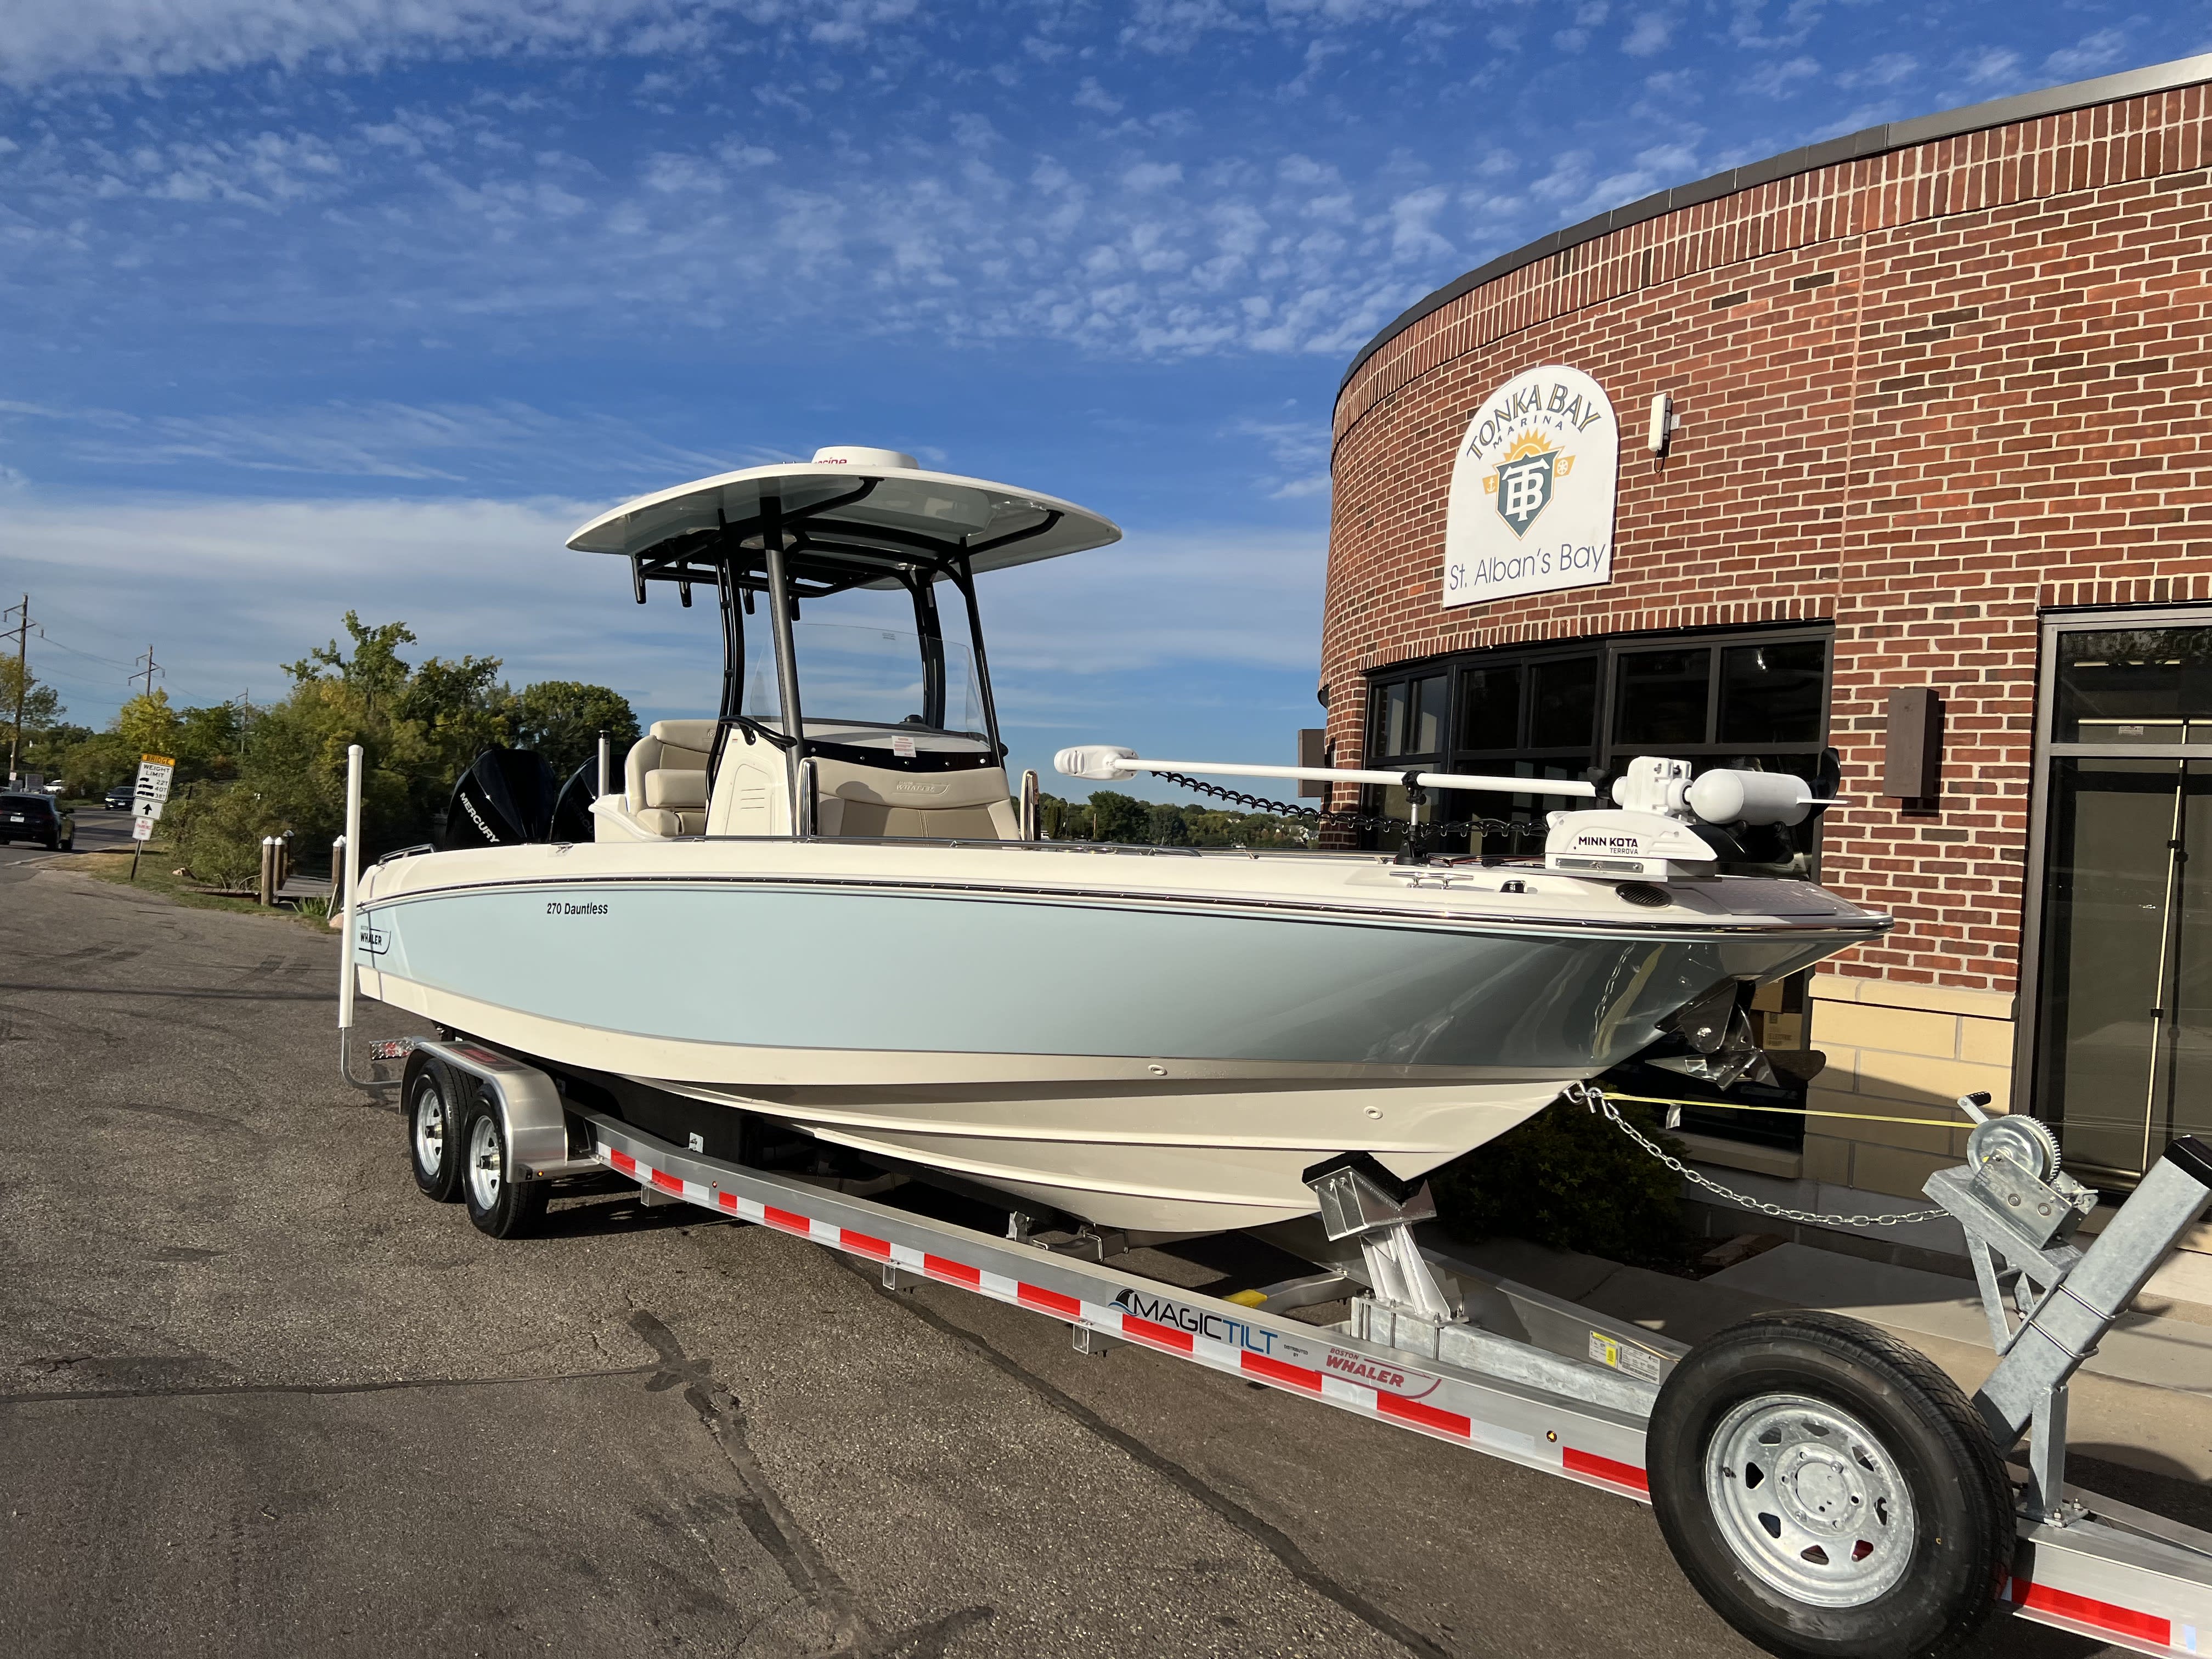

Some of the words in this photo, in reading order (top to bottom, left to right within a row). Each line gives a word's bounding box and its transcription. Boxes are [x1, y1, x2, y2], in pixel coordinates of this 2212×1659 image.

[1466, 385, 1542, 460] TONKA
[1546, 383, 1602, 433] BAY
[1493, 415, 1563, 449] MARINA
[1449, 564, 1468, 590] St.
[1474, 549, 1551, 586] Alban's
[1560, 543, 1606, 573] Bay
[146, 755, 171, 765] BRIDGE
[144, 764, 171, 772] WEIGHT
[460, 792, 500, 843] MERCURY
[1579, 837, 1606, 846] MINN
[1609, 837, 1638, 847] KOTA
[547, 902, 562, 915] 270
[565, 902, 608, 915] Dauntless
[360, 932, 382, 946] WHALER
[1284, 1344, 1308, 1355] DISTRIBUTED
[1330, 1347, 1359, 1361] BOSTON
[1326, 1355, 1404, 1387] WHALER
